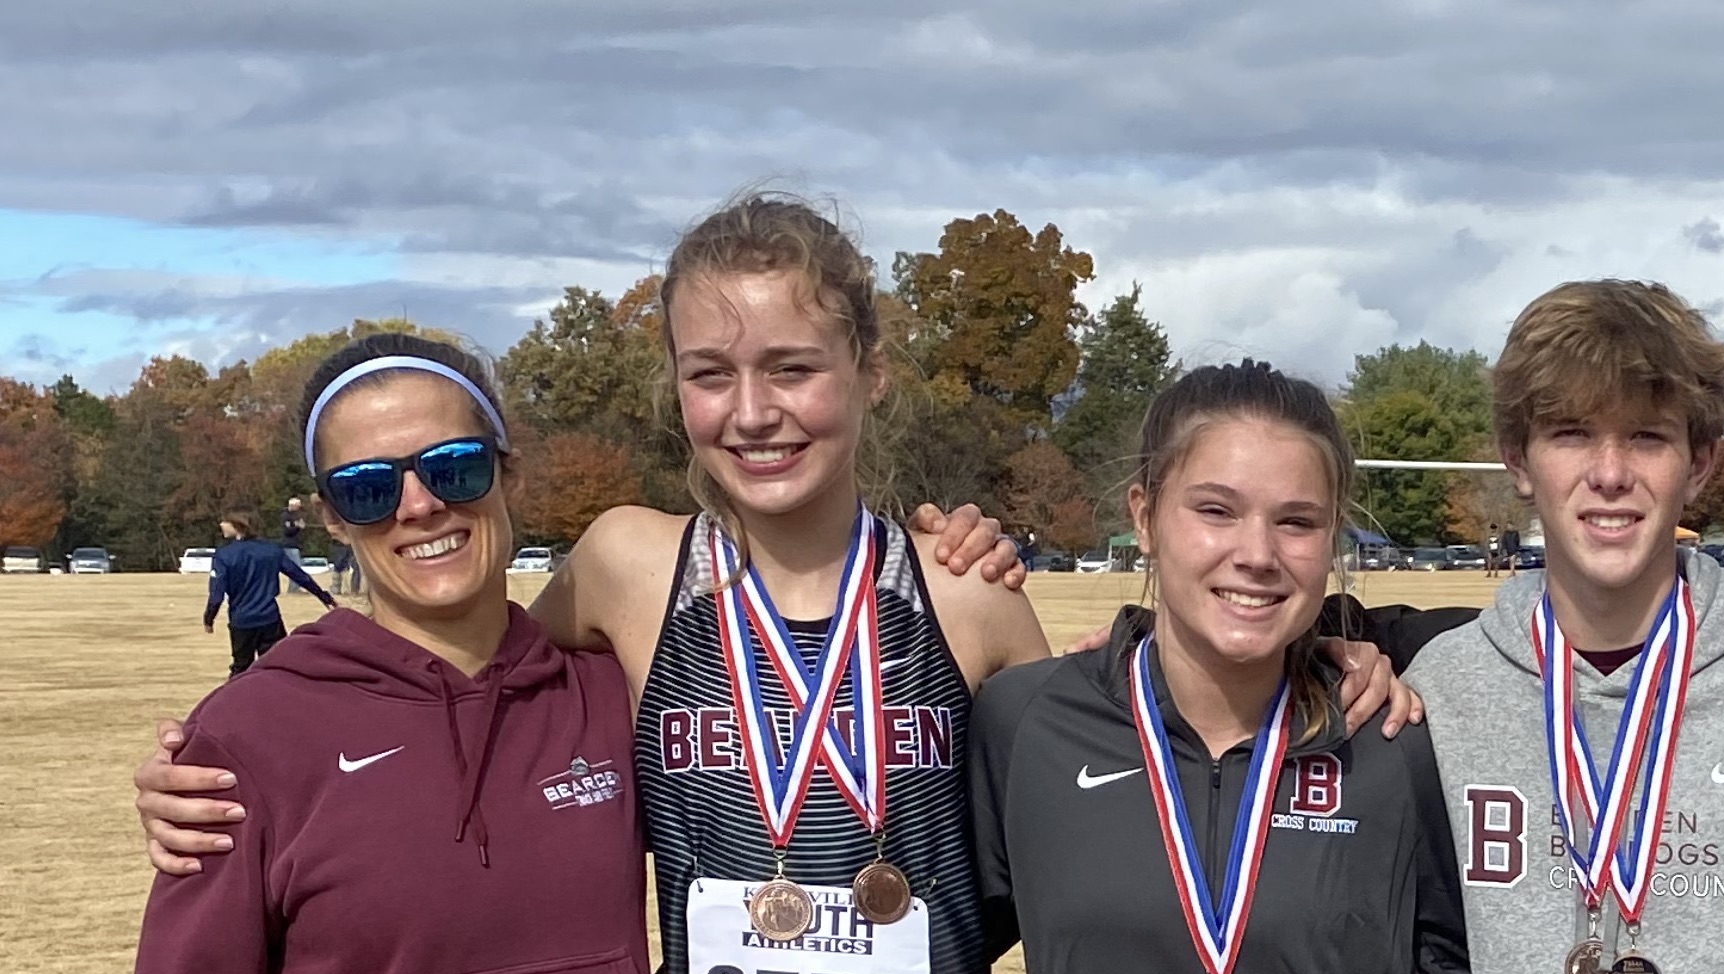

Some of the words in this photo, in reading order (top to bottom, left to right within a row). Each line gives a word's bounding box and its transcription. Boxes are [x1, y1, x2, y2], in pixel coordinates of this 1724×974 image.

[660, 705, 953, 774] BEEN
[1290, 751, 1342, 818] B
[1271, 813, 1304, 829] CROSS
[1308, 818, 1359, 834] COUNTRY
[1464, 784, 1529, 889] B
